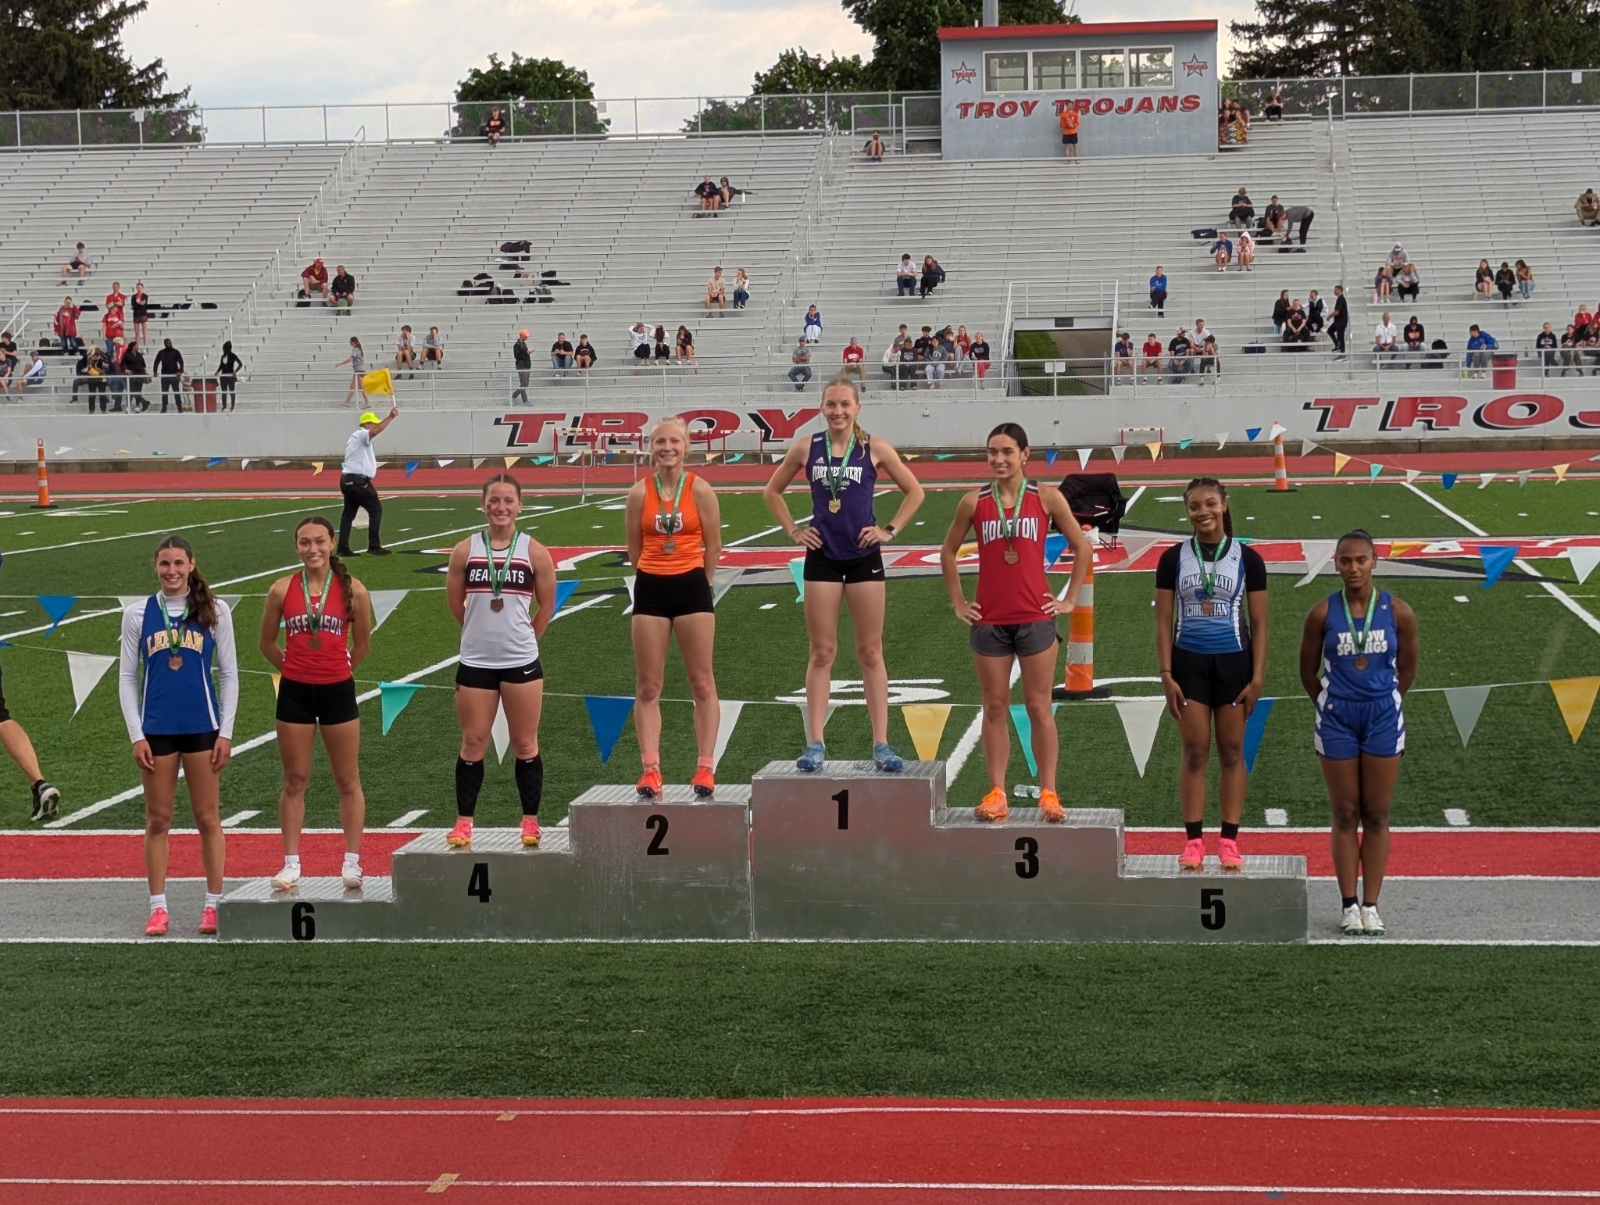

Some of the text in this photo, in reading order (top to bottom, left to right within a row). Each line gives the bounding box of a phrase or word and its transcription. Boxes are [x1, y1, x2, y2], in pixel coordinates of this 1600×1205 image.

[957, 94, 1201, 119] TROY TROJANS
[494, 408, 822, 447] TROY
[1303, 394, 1600, 432] TRO
[831, 789, 849, 830] 1
[646, 814, 669, 855] 2
[1014, 836, 1040, 879] 3
[467, 862, 492, 903] 4
[290, 901, 317, 941] 6
[1200, 888, 1227, 930] 5
